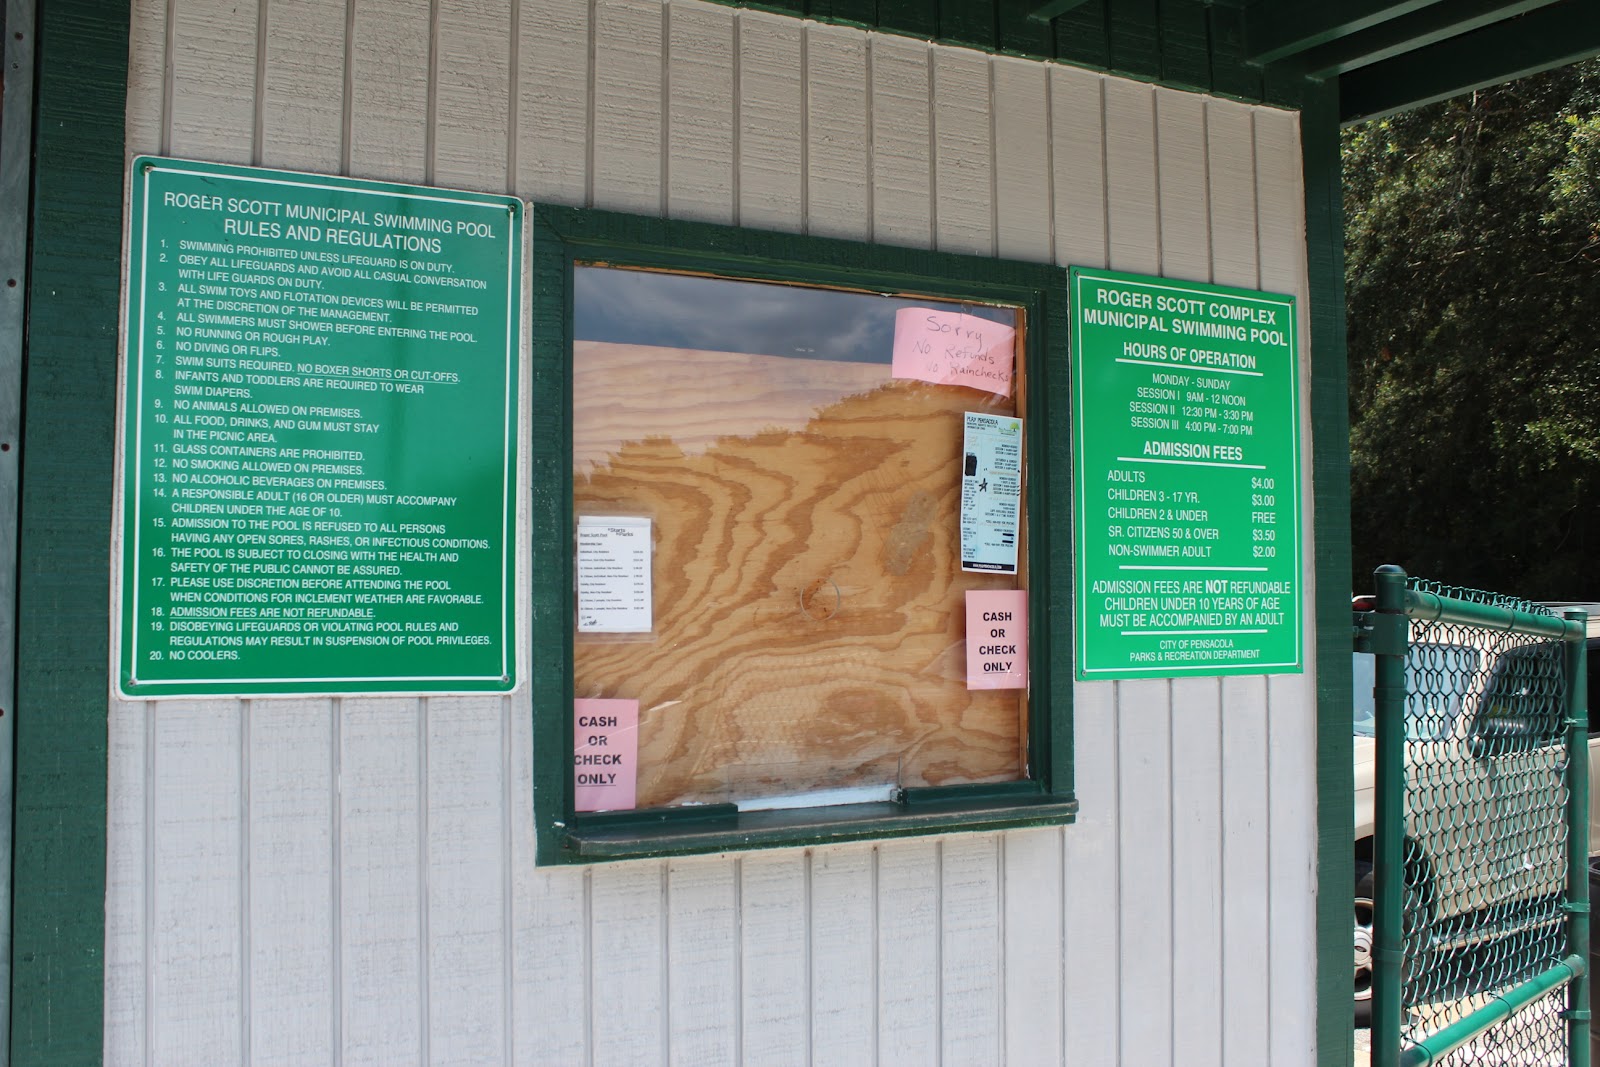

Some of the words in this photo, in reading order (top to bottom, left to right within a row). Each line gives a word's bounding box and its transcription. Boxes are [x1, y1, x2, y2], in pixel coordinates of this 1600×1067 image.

[164, 191, 222, 211] ROGER
[227, 198, 282, 217] SCOTT
[286, 203, 369, 225] MUNICIPAL
[374, 212, 452, 233] SWIMMING
[456, 221, 495, 238] POOL
[224, 218, 281, 238] RULES
[286, 224, 321, 242] AND
[326, 228, 441, 253] REGULATIONS
[160, 239, 168, 247] 1.
[179, 240, 233, 253] SWIMMING
[236, 245, 297, 259] PROHIBITED
[300, 250, 339, 262] UNLESS
[341, 254, 396, 268] LIFEGUARD
[399, 260, 408, 268] IS
[410, 260, 424, 270] ON
[427, 262, 454, 273] DUTY.
[1097, 288, 1152, 309] ROGER
[1156, 296, 1205, 315] SCOTT
[1209, 303, 1275, 324] COMPLEX
[926, 316, 982, 352] Sorry
[1085, 308, 1168, 332] MUNICIPAL
[1172, 318, 1246, 341] SWIMMING
[1250, 328, 1286, 346] POOL
[156, 326, 165, 334] 5.
[176, 326, 192, 336] NO
[194, 328, 241, 340] RUNNING
[244, 331, 259, 341] OR
[263, 332, 300, 344] ROUGH
[302, 335, 330, 345] PLAY.
[912, 338, 931, 355] No
[945, 344, 995, 365] Refunds
[1123, 341, 1167, 359] HOURS
[1170, 346, 1186, 361] OF
[1189, 348, 1255, 369] OPERATION
[1152, 373, 1189, 386] MONDAY
[1196, 377, 1230, 390] SUNDAY
[1136, 386, 1175, 400] SESSION
[1186, 391, 1203, 402] 9AM
[1211, 394, 1220, 404] 12
[1221, 394, 1246, 406] NOON
[154, 399, 163, 408] 9.
[173, 399, 189, 409] NO
[192, 400, 237, 412] ANIMALS
[240, 403, 289, 414] ALLOWED
[291, 405, 307, 415] ON
[309, 406, 362, 418] PREMISES.
[1129, 401, 1167, 414] SESSION
[1181, 406, 1202, 416] 12:30
[1204, 408, 1216, 418] PM
[1223, 410, 1239, 420] 3:30
[1241, 410, 1253, 421] PM
[1130, 416, 1169, 429] SESSION
[1185, 421, 1202, 431] 4:00
[1203, 422, 1216, 432] PM
[1222, 424, 1239, 434] 7:00
[1240, 425, 1252, 435] PM
[1143, 440, 1210, 458] ADMISSION
[1213, 445, 1242, 460] FEES
[153, 473, 166, 482] 13.
[172, 473, 188, 482] NO
[190, 474, 249, 485] ALCOHOLIC
[252, 476, 314, 487] BEVERAGES
[316, 478, 331, 488] ON
[334, 479, 387, 490] PREMISES.
[1107, 469, 1145, 482] ADULTS
[1251, 477, 1274, 489] $4.00
[1107, 488, 1156, 501] CHILDREN
[1158, 491, 1164, 501] 3
[1172, 491, 1183, 502] 17
[1184, 492, 1199, 502] YR.
[1251, 494, 1274, 506] $3.00
[1107, 507, 1156, 519] CHILDREN
[1159, 509, 1164, 519] 2
[1167, 509, 1173, 520] &
[1175, 509, 1208, 521] UNDER
[1251, 512, 1276, 523] FREE
[1108, 525, 1124, 537] SR.
[1127, 526, 1170, 538] CITIZENS
[1172, 528, 1183, 538] 50
[1185, 528, 1191, 538] &
[1193, 528, 1219, 539] OVER
[1252, 529, 1275, 541] $3.50
[1108, 544, 1179, 557] NON-SWIMMER
[1181, 546, 1212, 557] ADULT
[1252, 546, 1276, 557] $2.00
[1092, 580, 1150, 593] ADMISSION
[1154, 581, 1180, 593] FEES
[1182, 581, 1202, 593] ARE
[1205, 580, 1228, 593] NOT
[1230, 581, 1290, 593] REFUNDABLE
[1104, 597, 1157, 610] CHILDREN
[1161, 598, 1195, 610] UNDER
[1199, 598, 1209, 609] 10
[1212, 598, 1243, 609] YEARS
[1246, 597, 1258, 609] OF
[1261, 597, 1280, 609] AGE
[150, 607, 164, 616] 18.
[169, 607, 227, 618] ADMISSION
[230, 608, 256, 618] FEES
[259, 608, 279, 618] ARE
[283, 608, 304, 618] NOT
[307, 608, 375, 619] REFUNDABLE.
[983, 612, 1012, 621] CASH
[1099, 614, 1130, 627] MUST
[1132, 614, 1146, 626] BE
[1149, 613, 1222, 626] ACCOMPANIED
[1225, 613, 1237, 625] BY
[1239, 613, 1252, 624] AN
[1254, 612, 1284, 625] ADULT
[150, 622, 164, 630] 19.
[169, 622, 233, 631] DISOBEYING
[236, 622, 300, 631] LIFEGUARDS
[303, 622, 318, 631] OR
[321, 622, 373, 631] VIOLATING
[376, 622, 403, 631] POOL
[405, 622, 436, 631] RULES
[438, 622, 458, 631] AND
[991, 629, 1005, 637] OR
[979, 645, 1016, 655] CHECK
[1159, 640, 1176, 649] CITY
[1178, 640, 1188, 648] OF
[1190, 639, 1233, 648] PENSACOLA
[149, 651, 164, 660] 20.
[169, 650, 185, 660] NO
[187, 650, 240, 660] COOLERS.
[1129, 652, 1155, 661] PARKS
[1158, 652, 1162, 660] &
[1164, 651, 1211, 659] RECREATION
[1214, 649, 1260, 658] DEPARTMENT
[984, 662, 1012, 671] ONLY
[579, 717, 617, 726] CASH
[588, 736, 607, 746] OR
[574, 755, 622, 765] CHECK
[578, 774, 616, 784] ONLY
